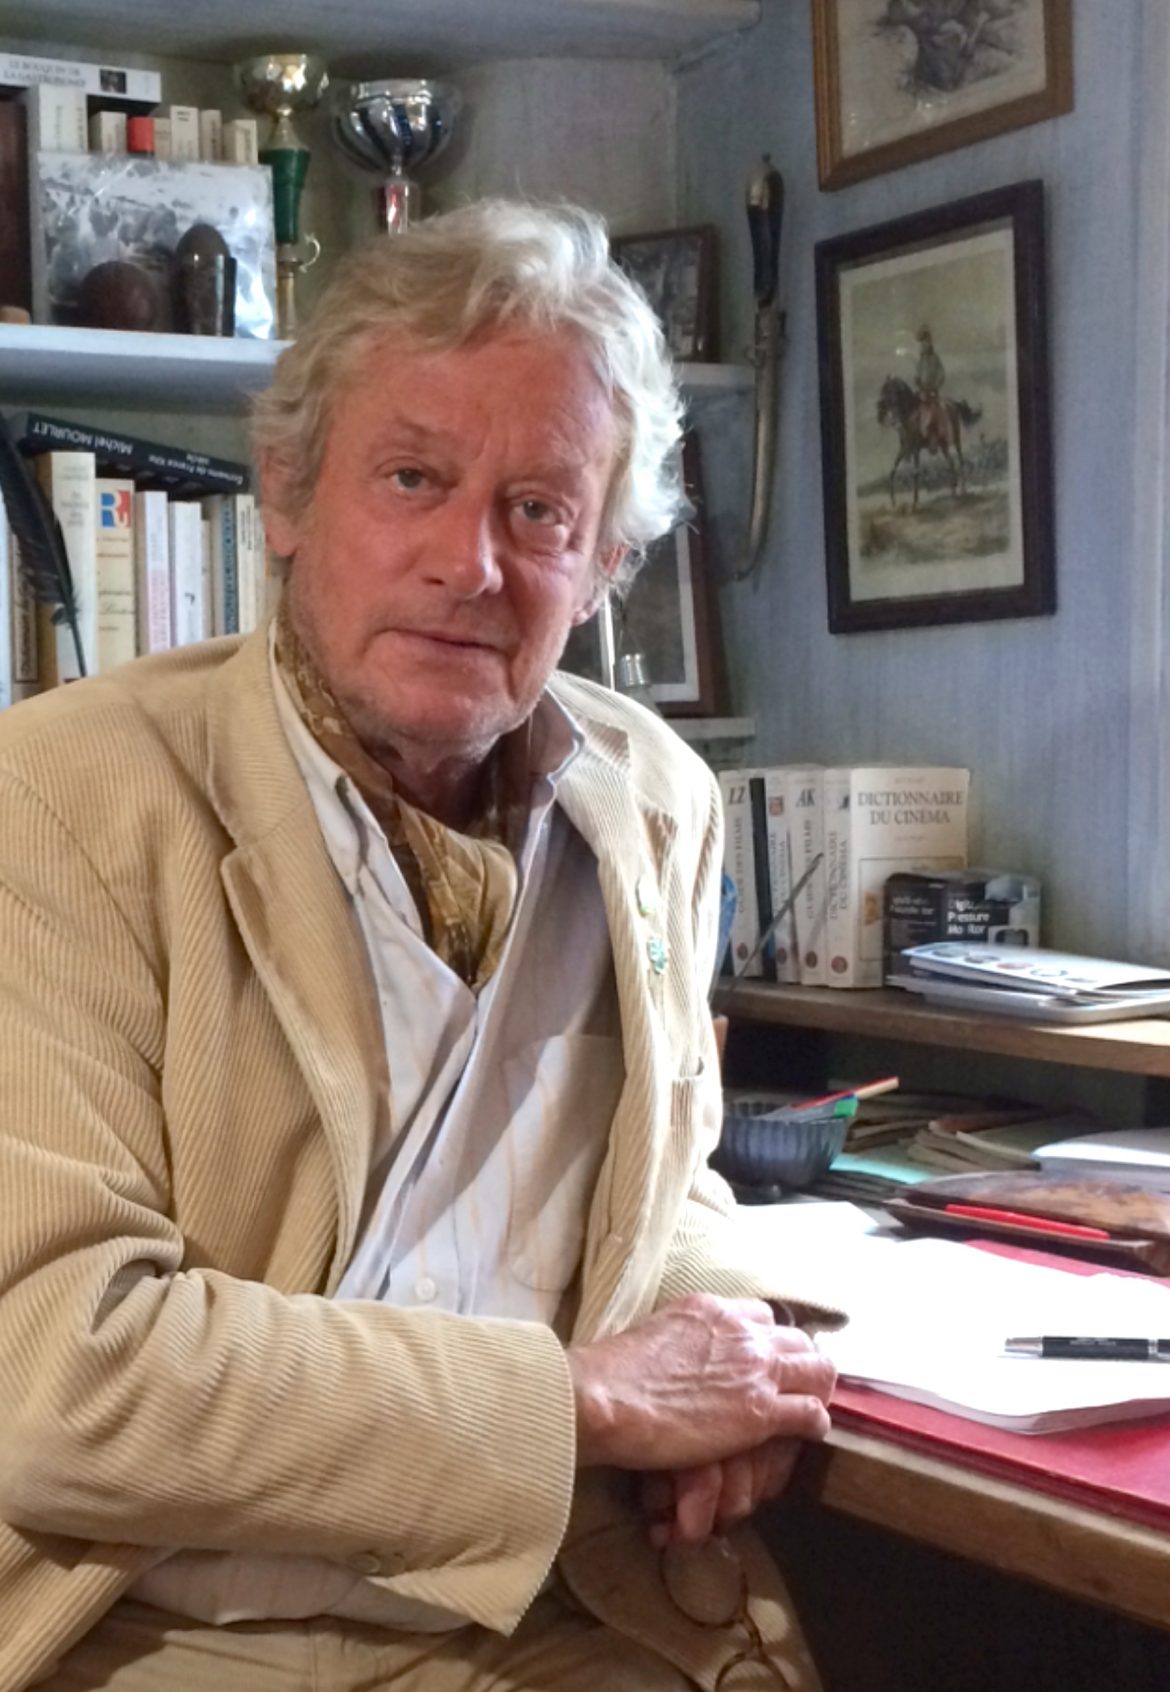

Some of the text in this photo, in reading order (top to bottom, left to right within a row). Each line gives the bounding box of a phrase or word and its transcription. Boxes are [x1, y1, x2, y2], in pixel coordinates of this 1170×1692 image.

[32, 421, 133, 455] Michel MOURLET
[857, 790, 963, 806] DICTIONNAIRE
[735, 817, 743, 850] FILMS
[870, 808, 951, 826] DU CINÉMA
[803, 819, 812, 854] FILMS
